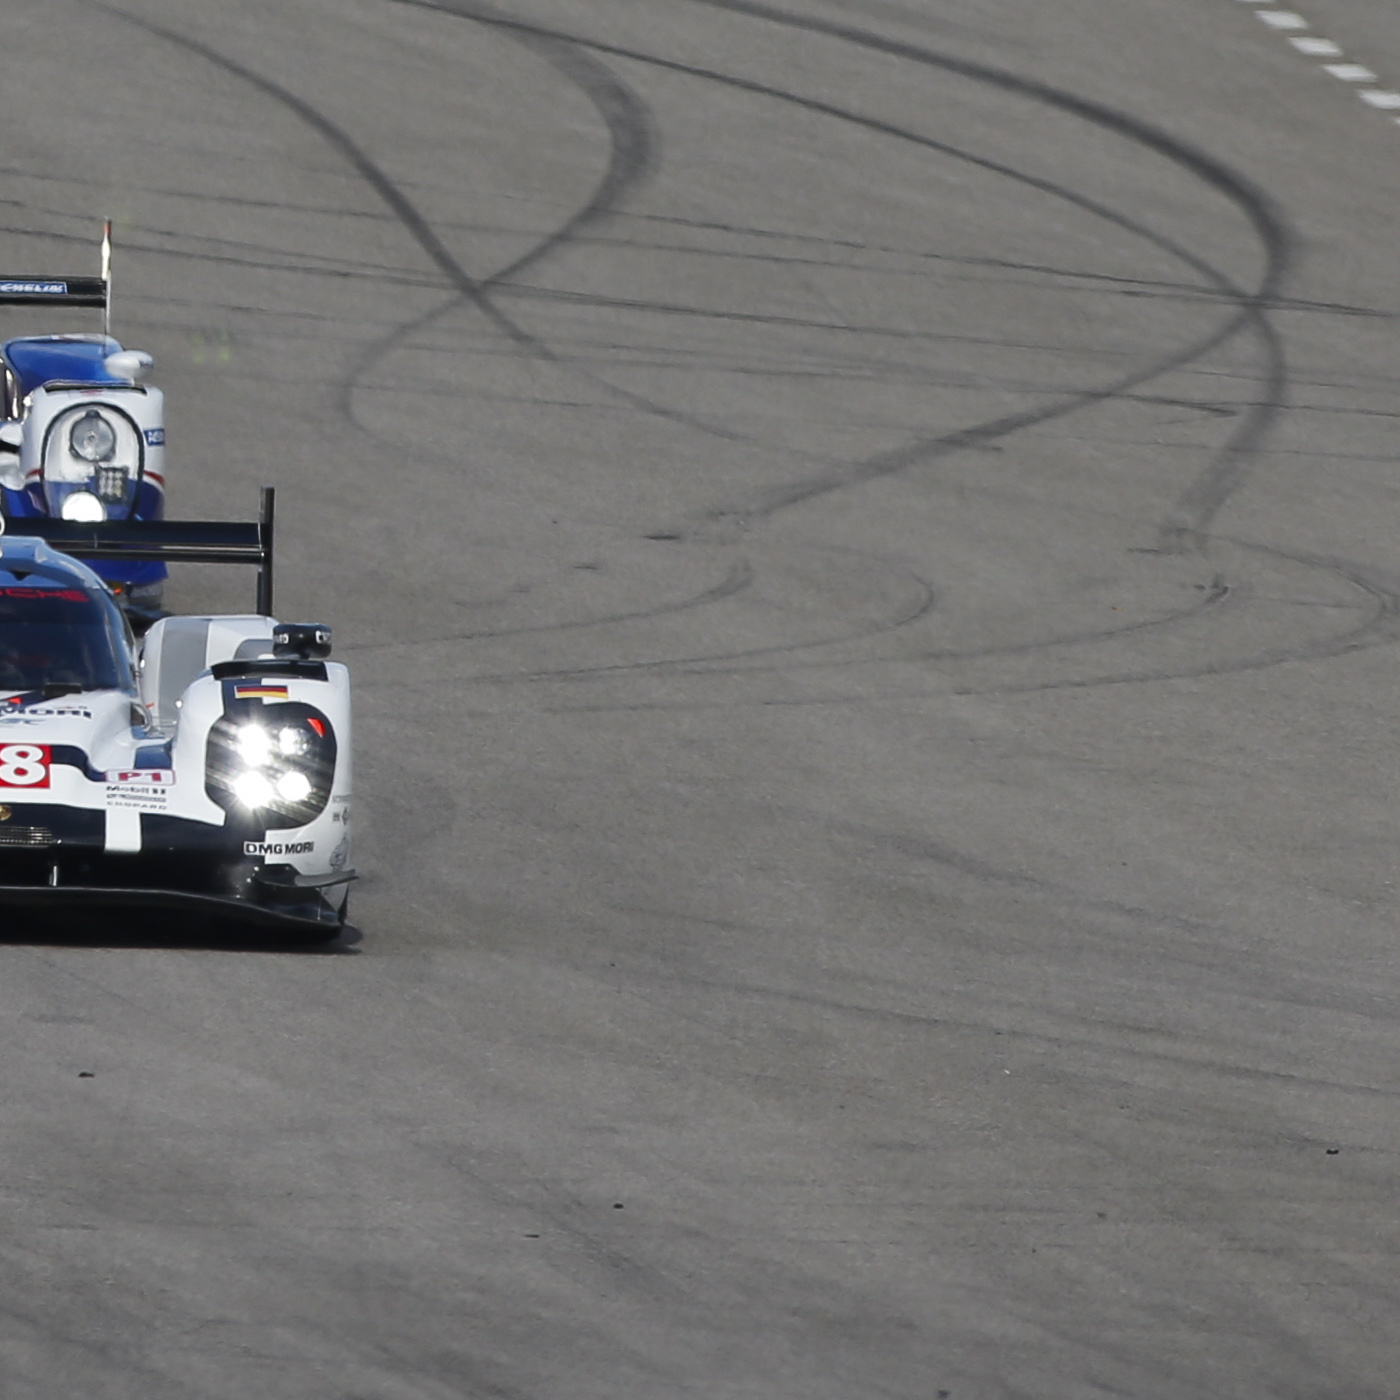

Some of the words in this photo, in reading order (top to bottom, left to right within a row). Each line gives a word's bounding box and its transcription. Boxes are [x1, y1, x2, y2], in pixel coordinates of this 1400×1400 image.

[0, 705, 93, 719] MORI
[118, 771, 163, 782] P1
[106, 785, 150, 794] Mobil
[245, 842, 283, 855] DMG
[284, 841, 315, 855] MORI
